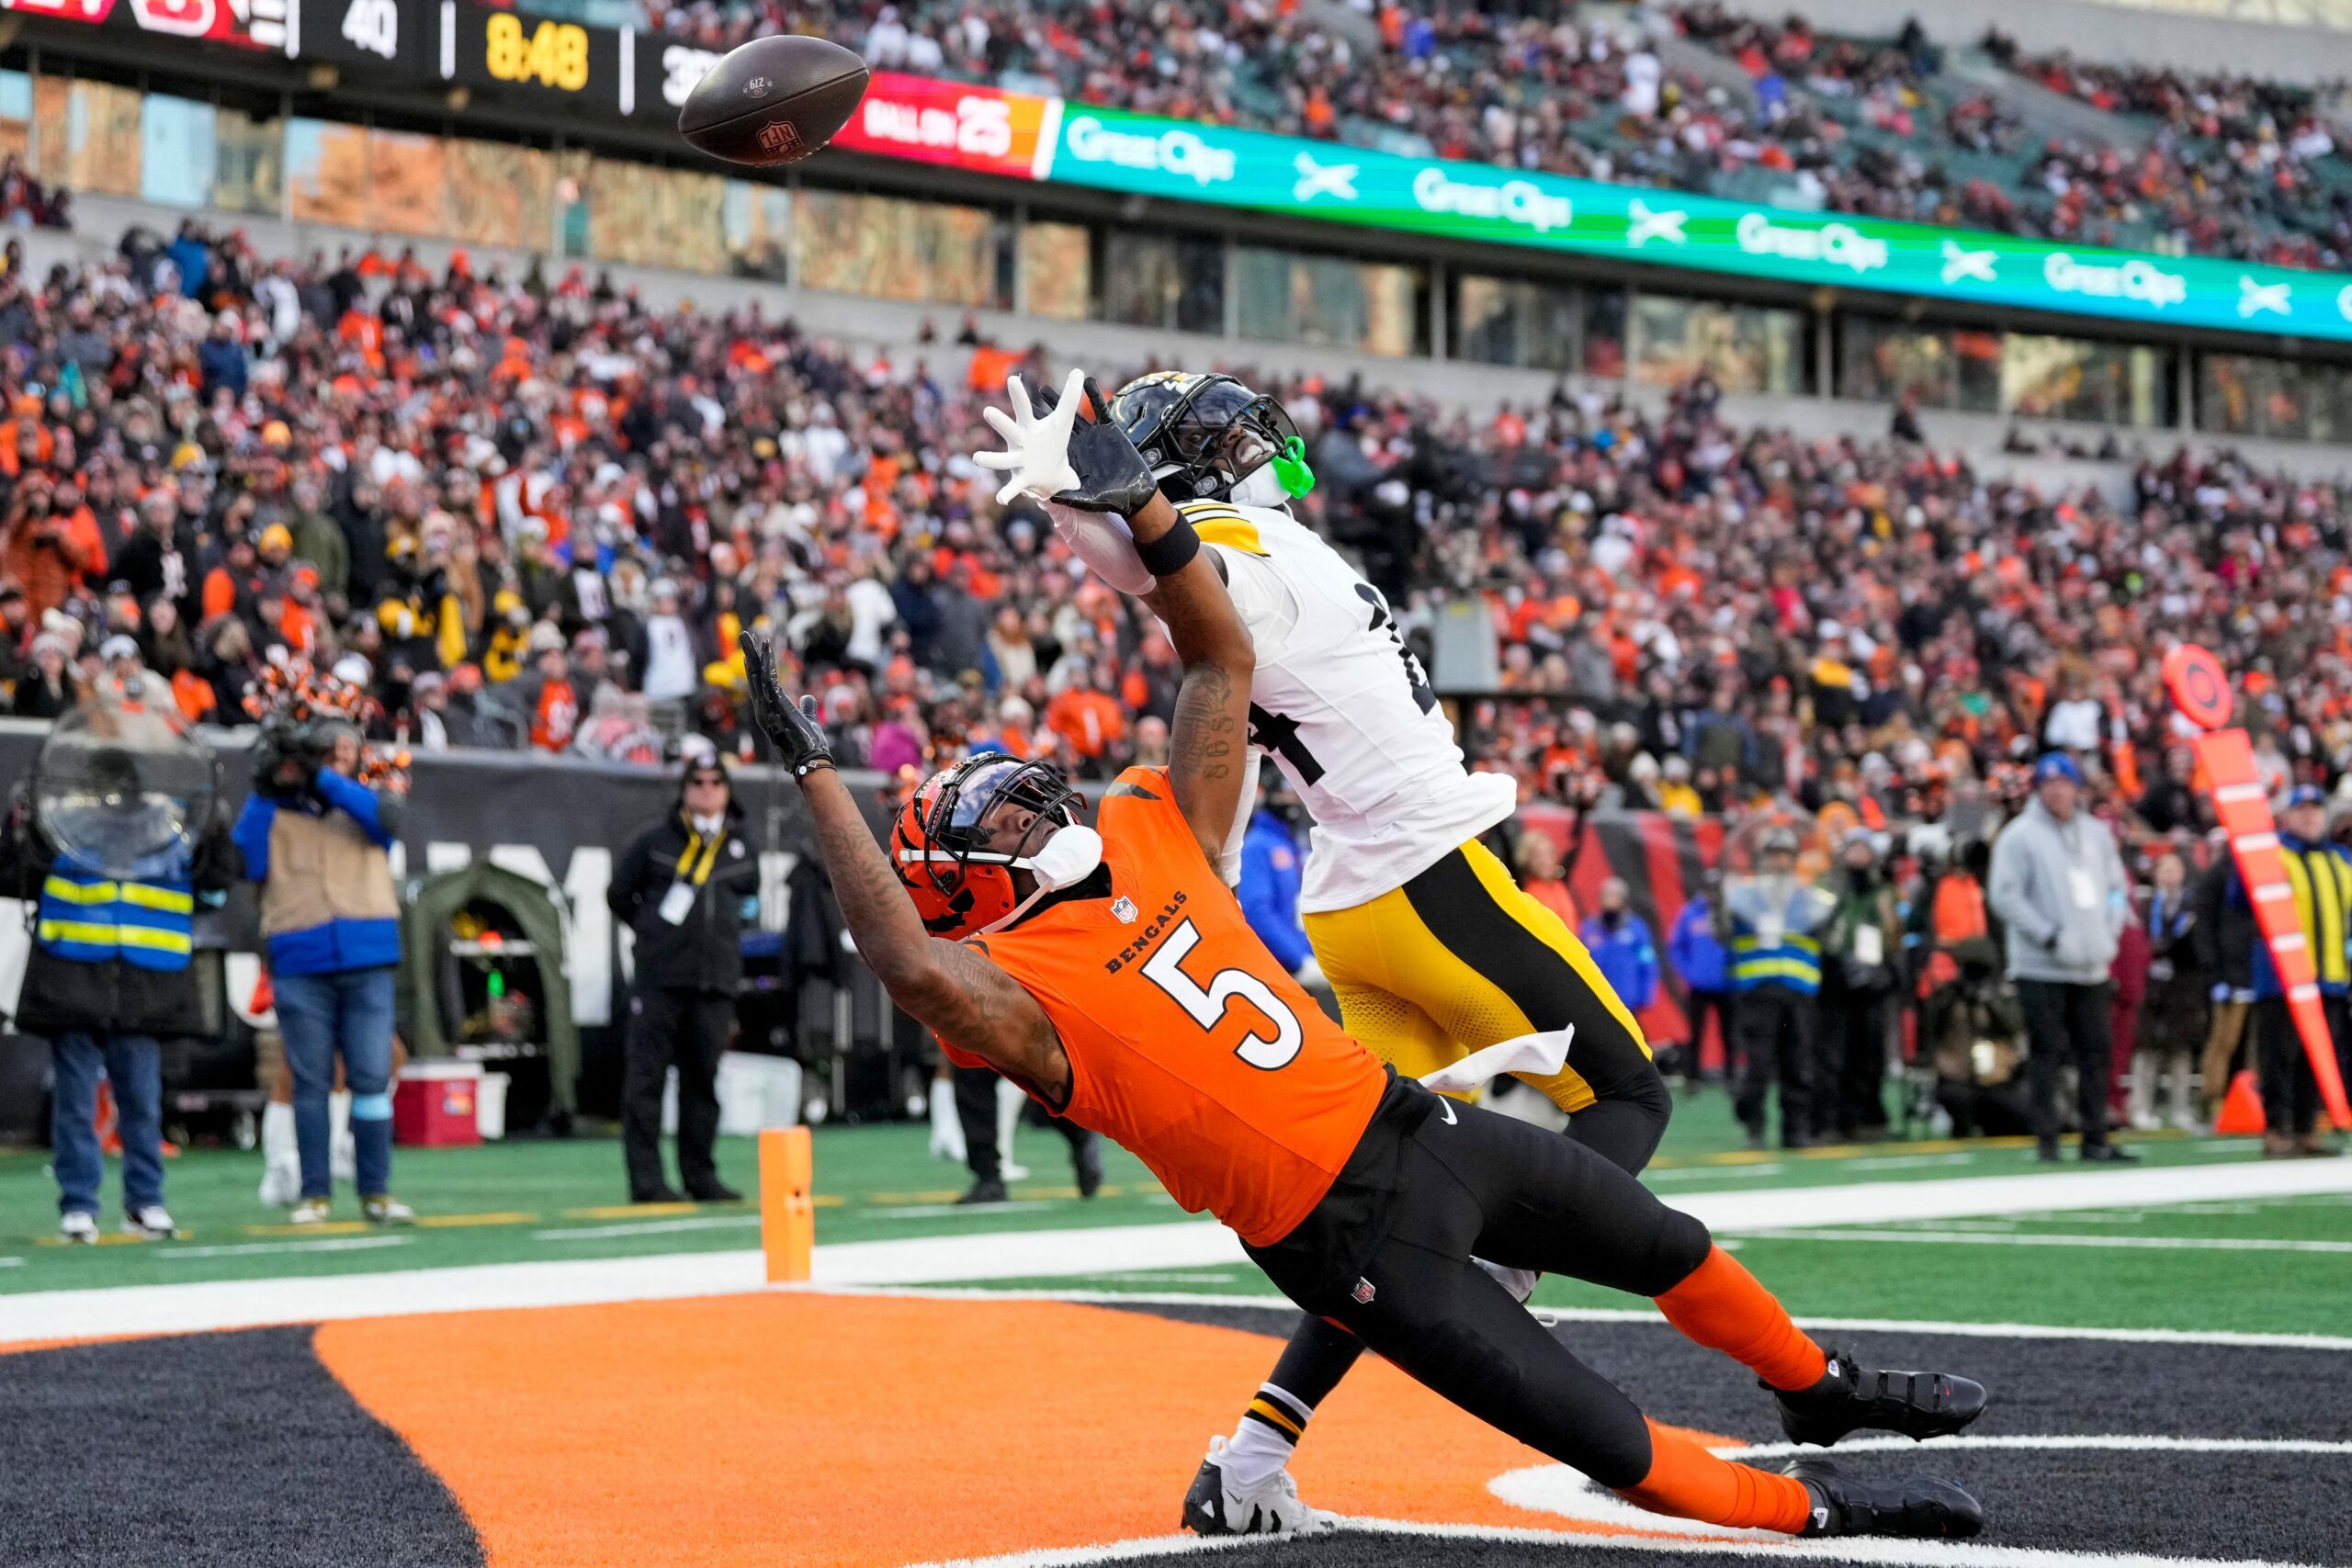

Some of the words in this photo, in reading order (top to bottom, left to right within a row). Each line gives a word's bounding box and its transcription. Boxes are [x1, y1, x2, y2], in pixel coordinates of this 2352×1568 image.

[486, 12, 589, 91] 8:48
[761, 125, 794, 146] NFL
[957, 95, 1012, 157] 25
[1104, 890, 1187, 974] BENGALS
[1138, 916, 1303, 1072] 5
